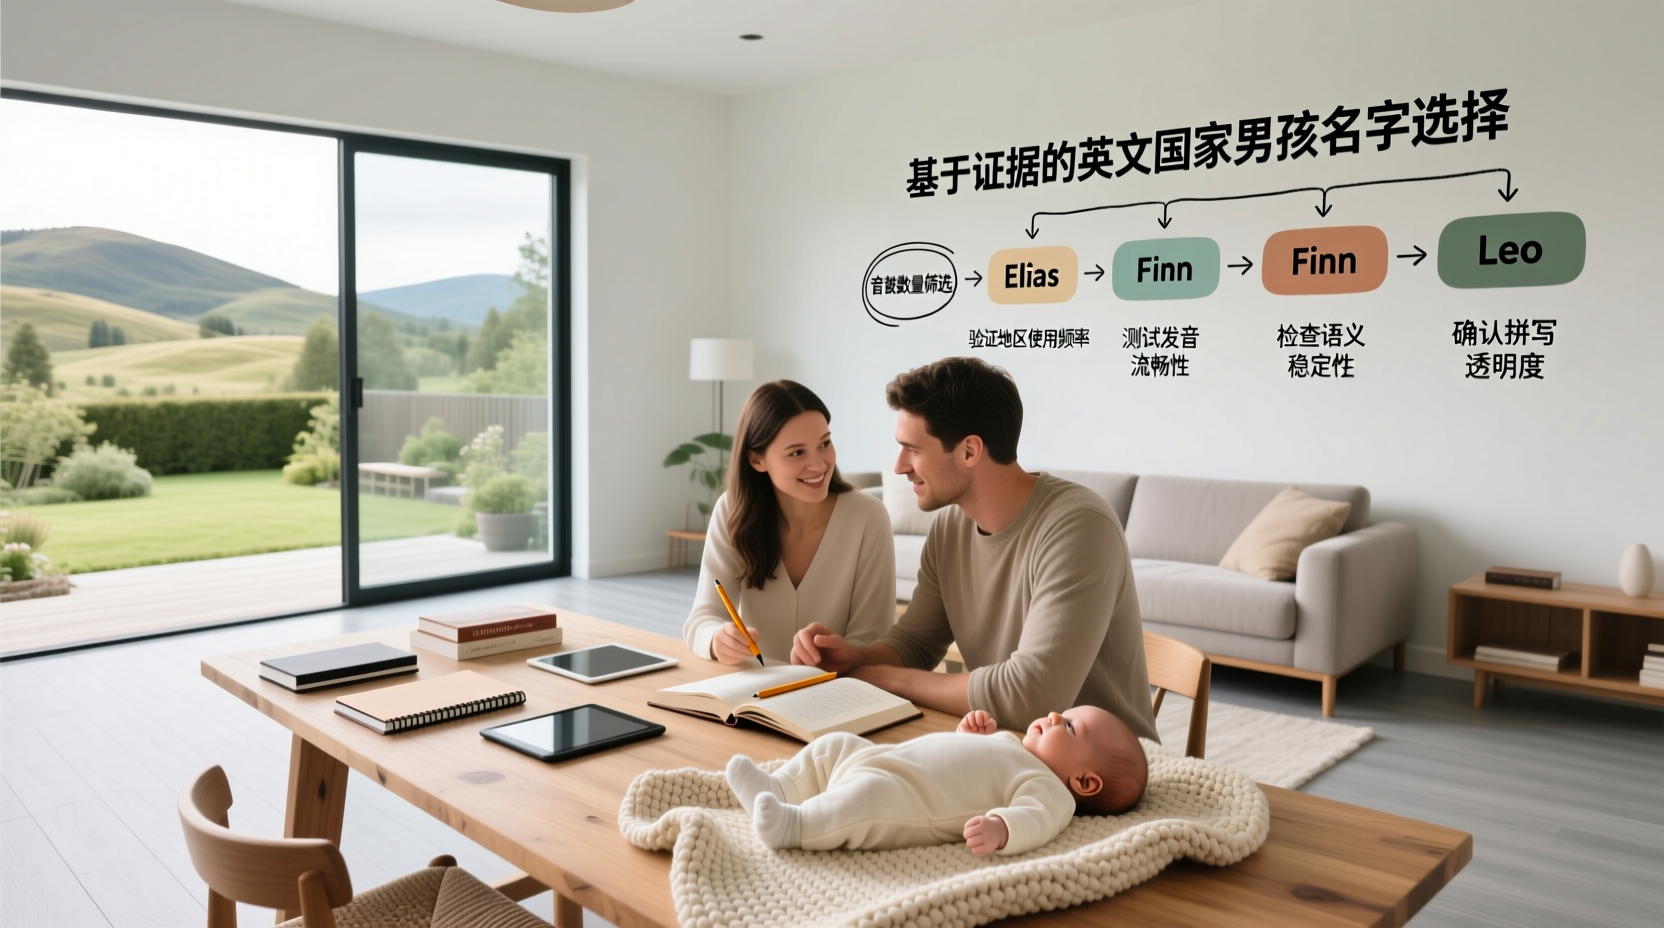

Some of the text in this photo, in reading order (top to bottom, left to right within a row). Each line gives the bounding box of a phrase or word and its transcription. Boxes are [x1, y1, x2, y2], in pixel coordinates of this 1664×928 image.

[906, 87, 1511, 199] 基于证据的英文国家男孩名字选择
[1292, 245, 1357, 276] Finn
[1478, 234, 1543, 266] Leo
[1005, 261, 1060, 289] Elias
[1137, 255, 1193, 283] Finn
[1122, 324, 1200, 349] 测试发音
[1276, 322, 1366, 349] 检查语义
[1451, 318, 1557, 347] 确认拼写
[1130, 352, 1190, 378] 流畅性
[1287, 352, 1355, 379] 稳定性
[1465, 351, 1545, 380] 透明度
